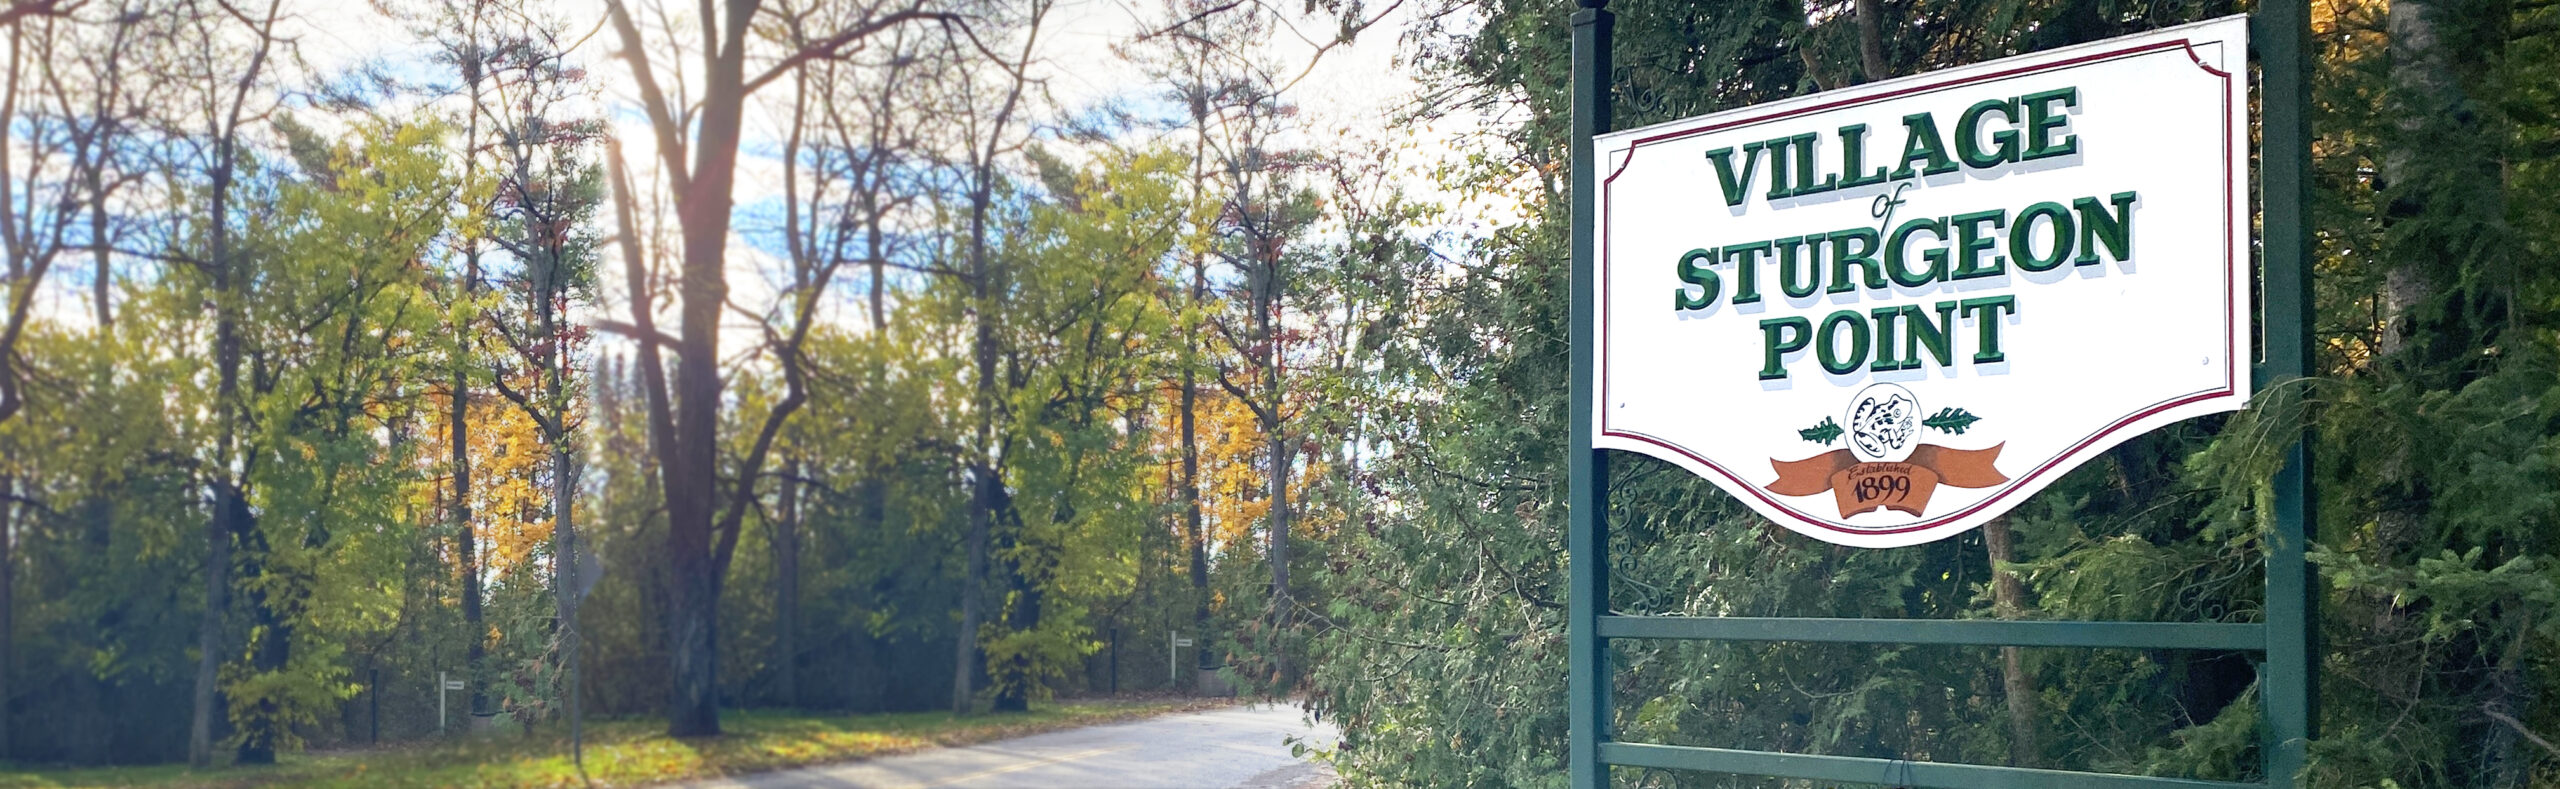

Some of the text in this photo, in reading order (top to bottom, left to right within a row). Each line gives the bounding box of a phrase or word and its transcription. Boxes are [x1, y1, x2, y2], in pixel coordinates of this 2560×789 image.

[1706, 86, 2079, 208] VILLAGE
[1872, 182, 1912, 238] of
[1675, 191, 2137, 312] STURGEON
[1759, 295, 2016, 380] POINT
[1848, 463, 1914, 480] Established
[1853, 475, 1911, 504] 1899
